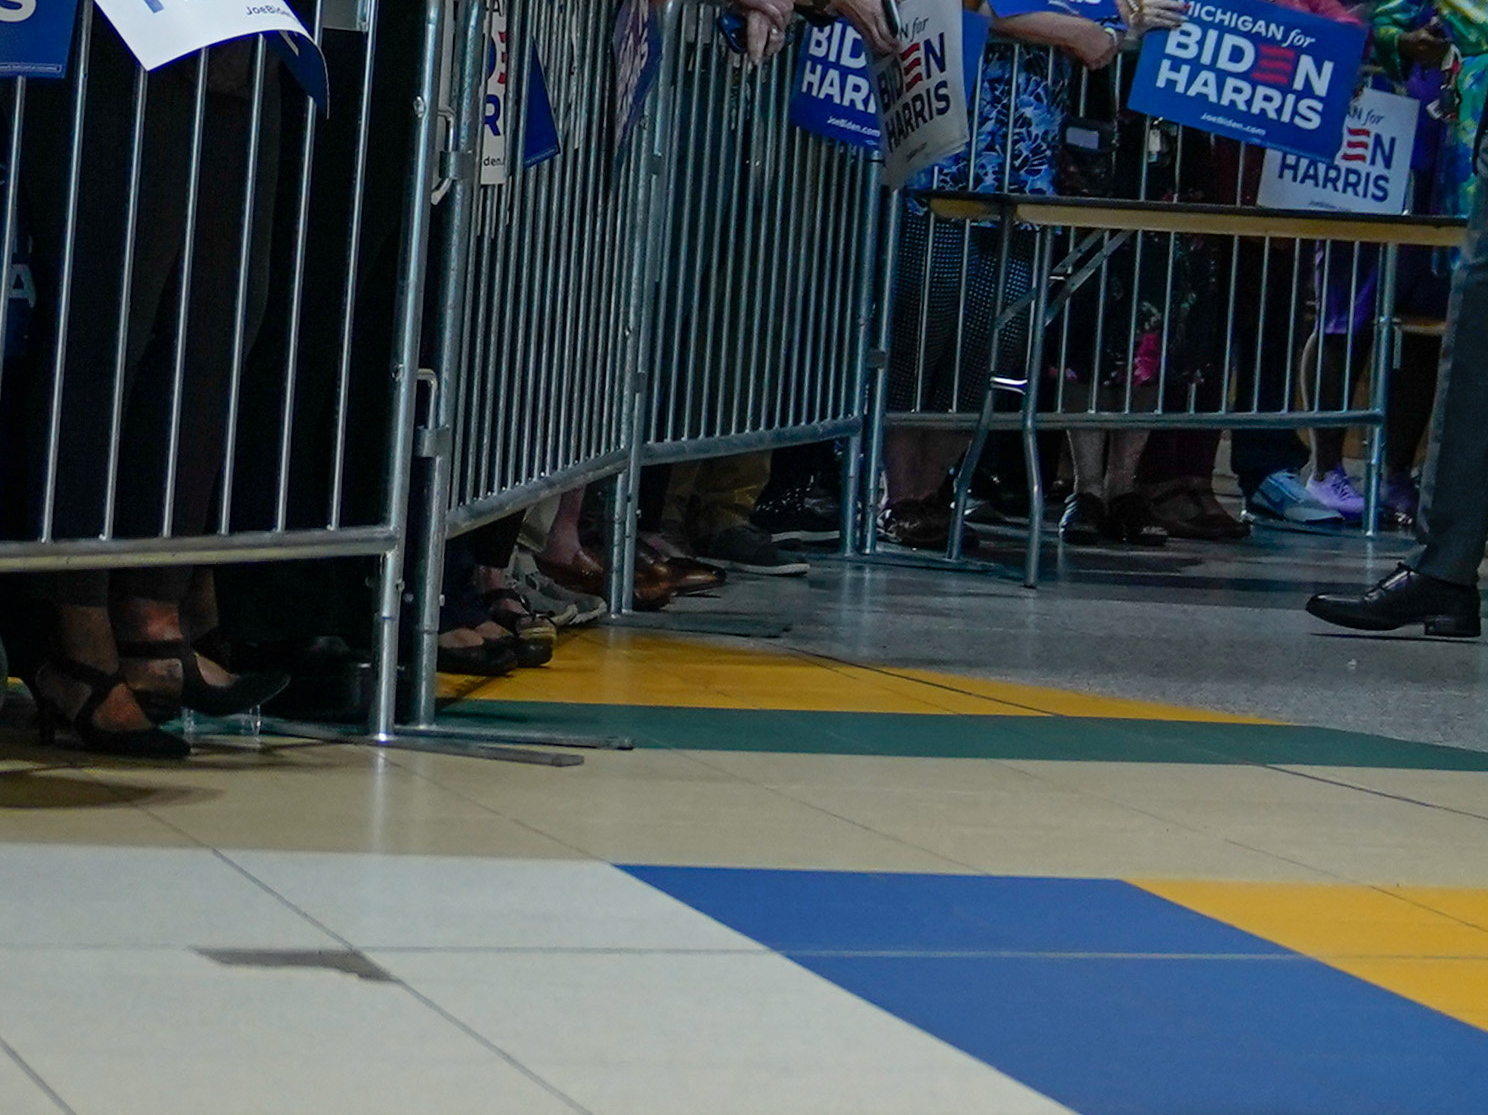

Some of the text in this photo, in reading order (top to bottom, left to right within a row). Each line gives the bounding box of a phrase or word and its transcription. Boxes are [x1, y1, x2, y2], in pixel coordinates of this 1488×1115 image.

[808, 22, 868, 69] BID
[910, 17, 929, 43] for
[1283, 29, 1316, 48] for
[1164, 22, 1335, 98] BIDEN
[801, 60, 877, 114] HAR
[1155, 58, 1323, 131] HARRIS
[884, 80, 951, 153] HARRIS
[1362, 107, 1385, 126] for
[1278, 152, 1390, 203] HARRIS
